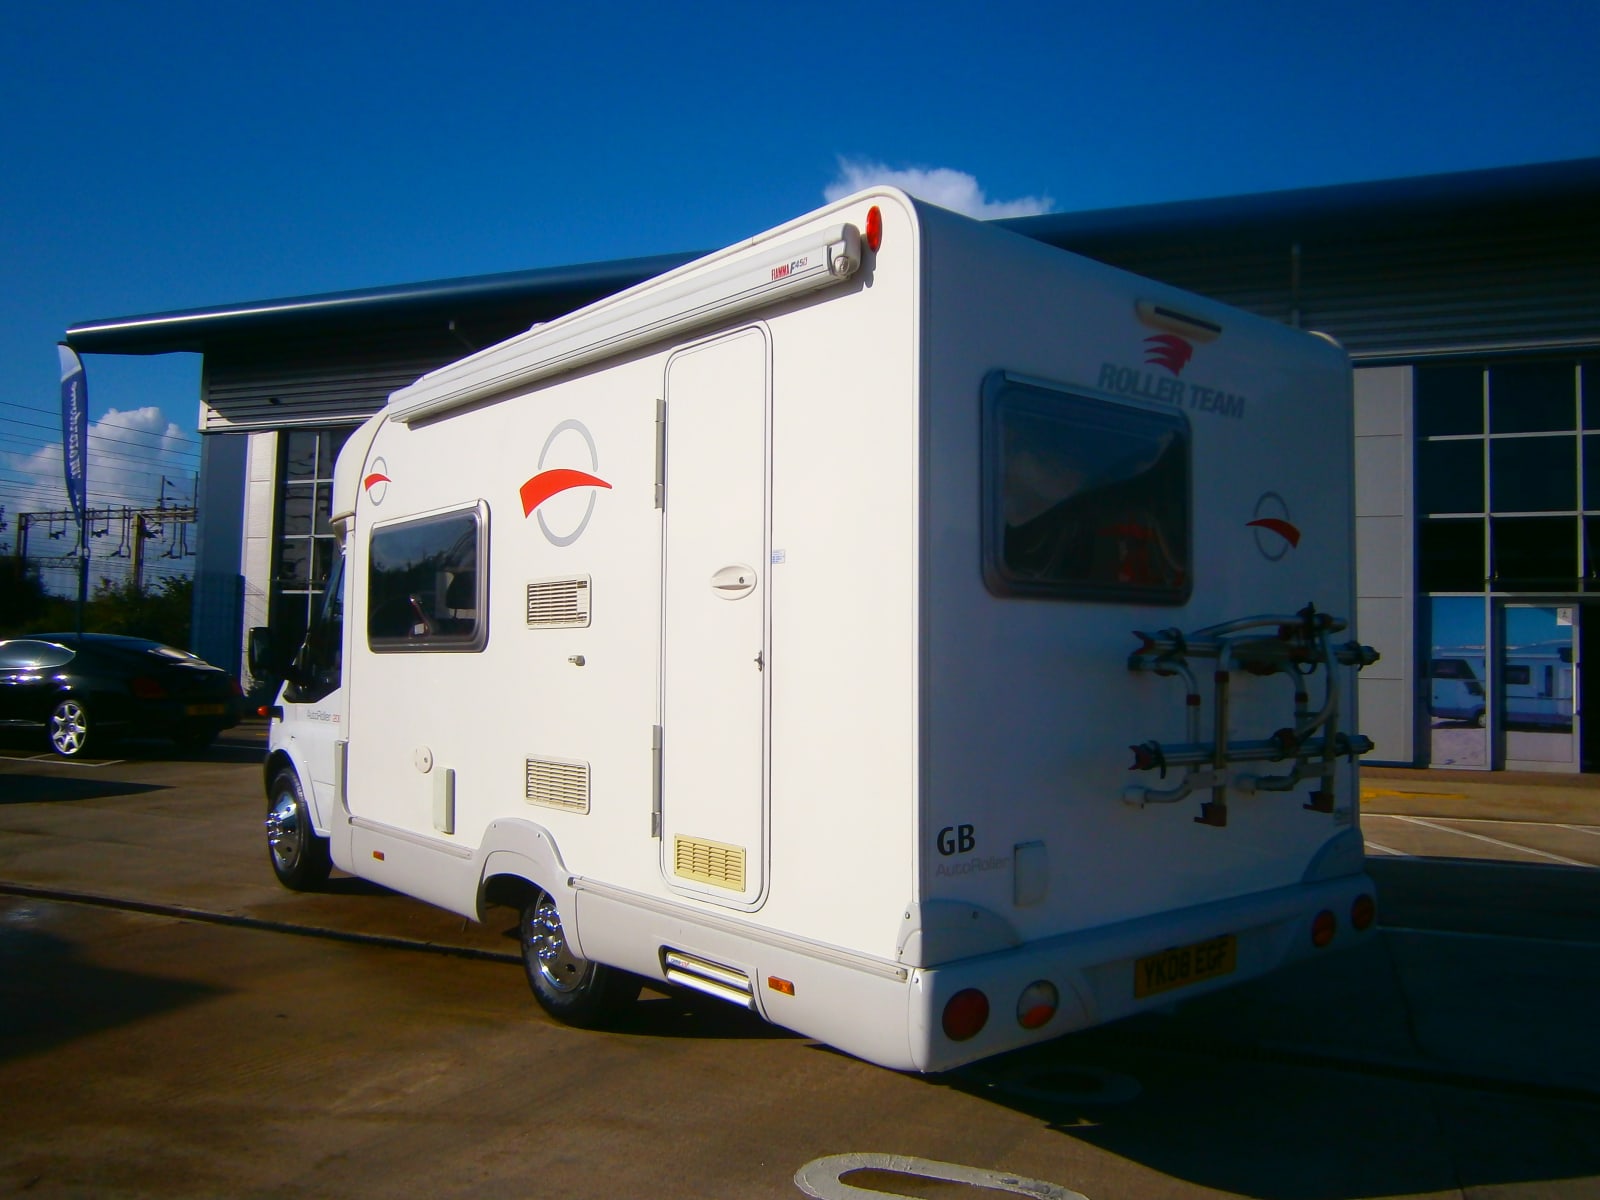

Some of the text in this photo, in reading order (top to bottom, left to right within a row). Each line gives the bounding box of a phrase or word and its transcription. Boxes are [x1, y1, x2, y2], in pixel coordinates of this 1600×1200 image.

[1098, 362, 1247, 419] ROLLER TEAM
[936, 823, 976, 856] GB
